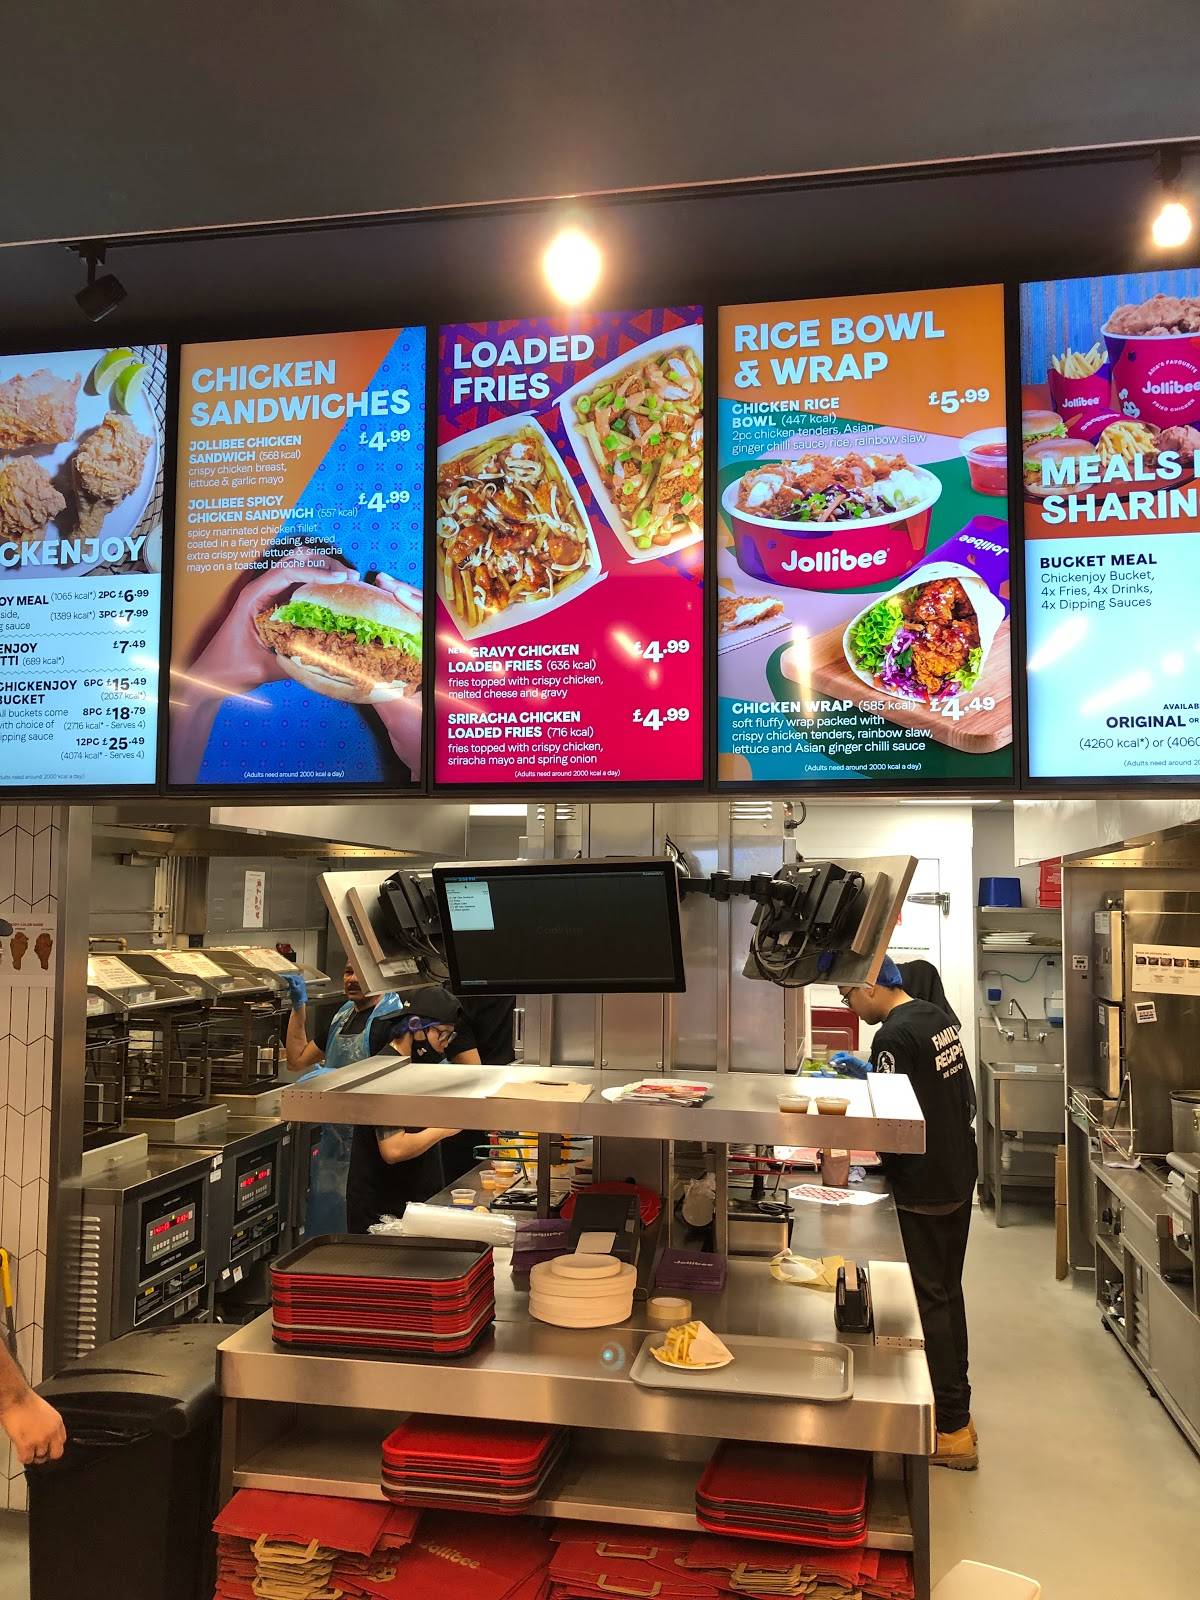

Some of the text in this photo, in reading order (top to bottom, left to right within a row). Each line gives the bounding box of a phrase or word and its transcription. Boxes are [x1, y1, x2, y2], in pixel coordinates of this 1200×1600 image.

[735, 311, 945, 353] RICE BOWL
[454, 334, 594, 370] LOADED
[192, 359, 336, 393] CHICKEN
[734, 351, 888, 388] & WRAP
[454, 372, 550, 404] FRIES
[1142, 380, 1200, 394] Jollibee
[191, 389, 411, 427] SANDWICHES
[732, 397, 840, 414] CHICKEN RICE
[928, 388, 990, 414] £5.99
[732, 416, 776, 428] BOWL
[732, 423, 874, 442] 2pc chicken tenders, Asian
[190, 435, 301, 451] JOLLIBEE CHICKEN
[360, 429, 411, 451] £4.99
[732, 433, 926, 455] ginger chilli sauce, rainbow slaw
[189, 452, 256, 464] SANDWICH
[188, 464, 252, 477] crispy chicken
[1041, 451, 1182, 487] MEALS
[188, 475, 283, 489] lettuce garlic mayo
[188, 496, 283, 509] JOLLIBEE SPICY
[358, 491, 410, 512] £4.99
[1041, 488, 1197, 525] SHARIN
[188, 508, 313, 524] CHICKEN SANDWICH
[188, 523, 317, 539] spicy marinated chicken fillet
[187, 534, 335, 549] coated fiery breading, served
[0, 536, 146, 568] CKENJOY
[187, 546, 342, 561] extra crispy with lettuce sriracha
[187, 559, 325, 573] mayo toasted brioche bun
[781, 548, 887, 573] Jollibee
[1040, 554, 1157, 569] BUCKET MEAL
[1041, 571, 1155, 583] Chickenjoy Bucket,
[98, 589, 149, 603] 2PC £6.99
[1060, 584, 1153, 596] Fries, Drinks,
[17, 595, 48, 606] MEAL
[1059, 598, 1152, 611] Dipping Sauces
[99, 609, 148, 622] 3PC £7.99
[5, 622, 30, 630] sauce
[113, 640, 145, 653] £7.49
[471, 645, 517, 658] GRAVY
[519, 644, 579, 656] CHICKEN
[633, 639, 690, 663] £4.99
[448, 659, 596, 673] LOADED FRIES kcal)
[0, 680, 77, 692] CHICKENJOY
[84, 678, 146, 691] 6PC £15.49
[448, 674, 604, 689] fries topped with crispy chicken,
[448, 688, 568, 699] melted cheese and gravy
[9, 708, 42, 717] buckets
[44, 709, 68, 717] come
[83, 706, 145, 720] 8PC £18.79
[732, 700, 853, 715] CHICKEN WRAP
[930, 696, 996, 720] £4.49
[448, 711, 580, 724] SRIRACHA CHICKEN
[633, 708, 690, 731] £4.99
[732, 715, 884, 729] soft fluffy wrap packed with
[1106, 716, 1186, 728] ORIGINAL
[16, 721, 46, 729] choice
[28, 733, 53, 741] sauce
[448, 726, 594, 739] LOADED FRIES kcal)
[732, 727, 933, 742] crispy chicken tenders, rainbow slaw,
[76, 737, 144, 751] 12PC £25.49
[448, 741, 604, 755] fries topped with crispy chicken,
[732, 741, 925, 755] lettuce and Asian ginger chilli sauce
[1080, 738, 1113, 750] (4260
[448, 754, 597, 766] sriracha mayo and spring onion
[515, 770, 535, 778] (Adults
[607, 769, 621, 778] day)
